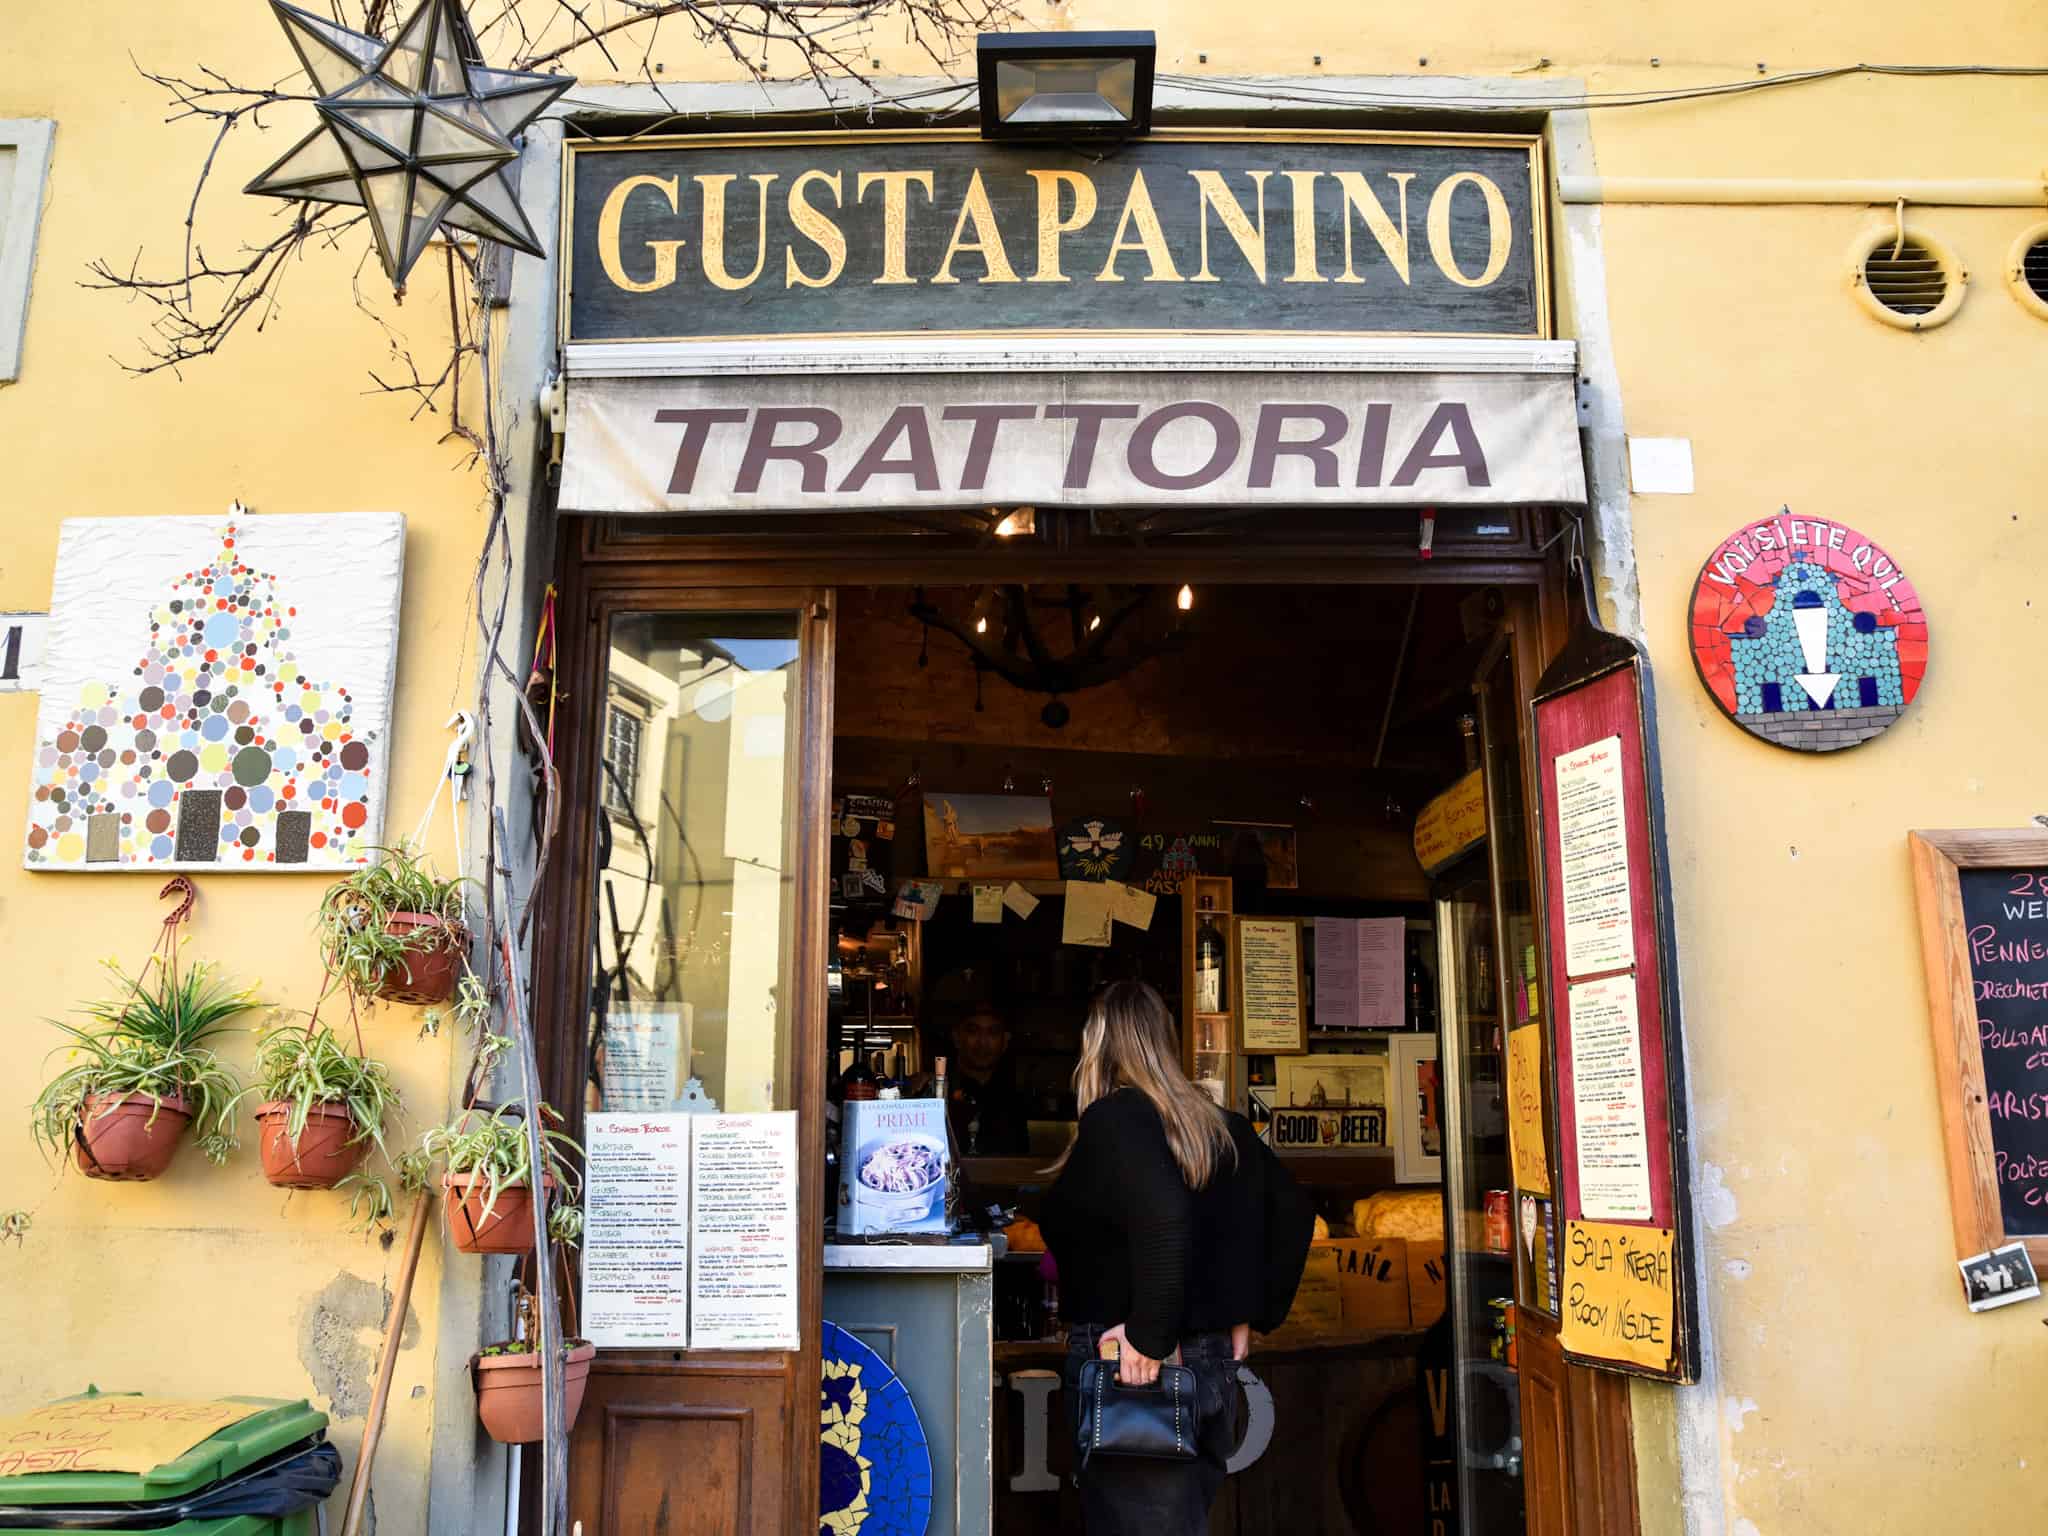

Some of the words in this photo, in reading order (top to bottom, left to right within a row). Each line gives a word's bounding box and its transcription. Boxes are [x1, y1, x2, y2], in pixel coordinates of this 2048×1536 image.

[597, 167, 1512, 291] GUSTAPANINO
[653, 401, 1491, 496] TRATTORIA
[876, 1111, 927, 1129] PRIMI
[1276, 1115, 1318, 1143] GOOD
[1341, 1115, 1380, 1143] BEER
[1571, 1229, 1613, 1272] SALA
